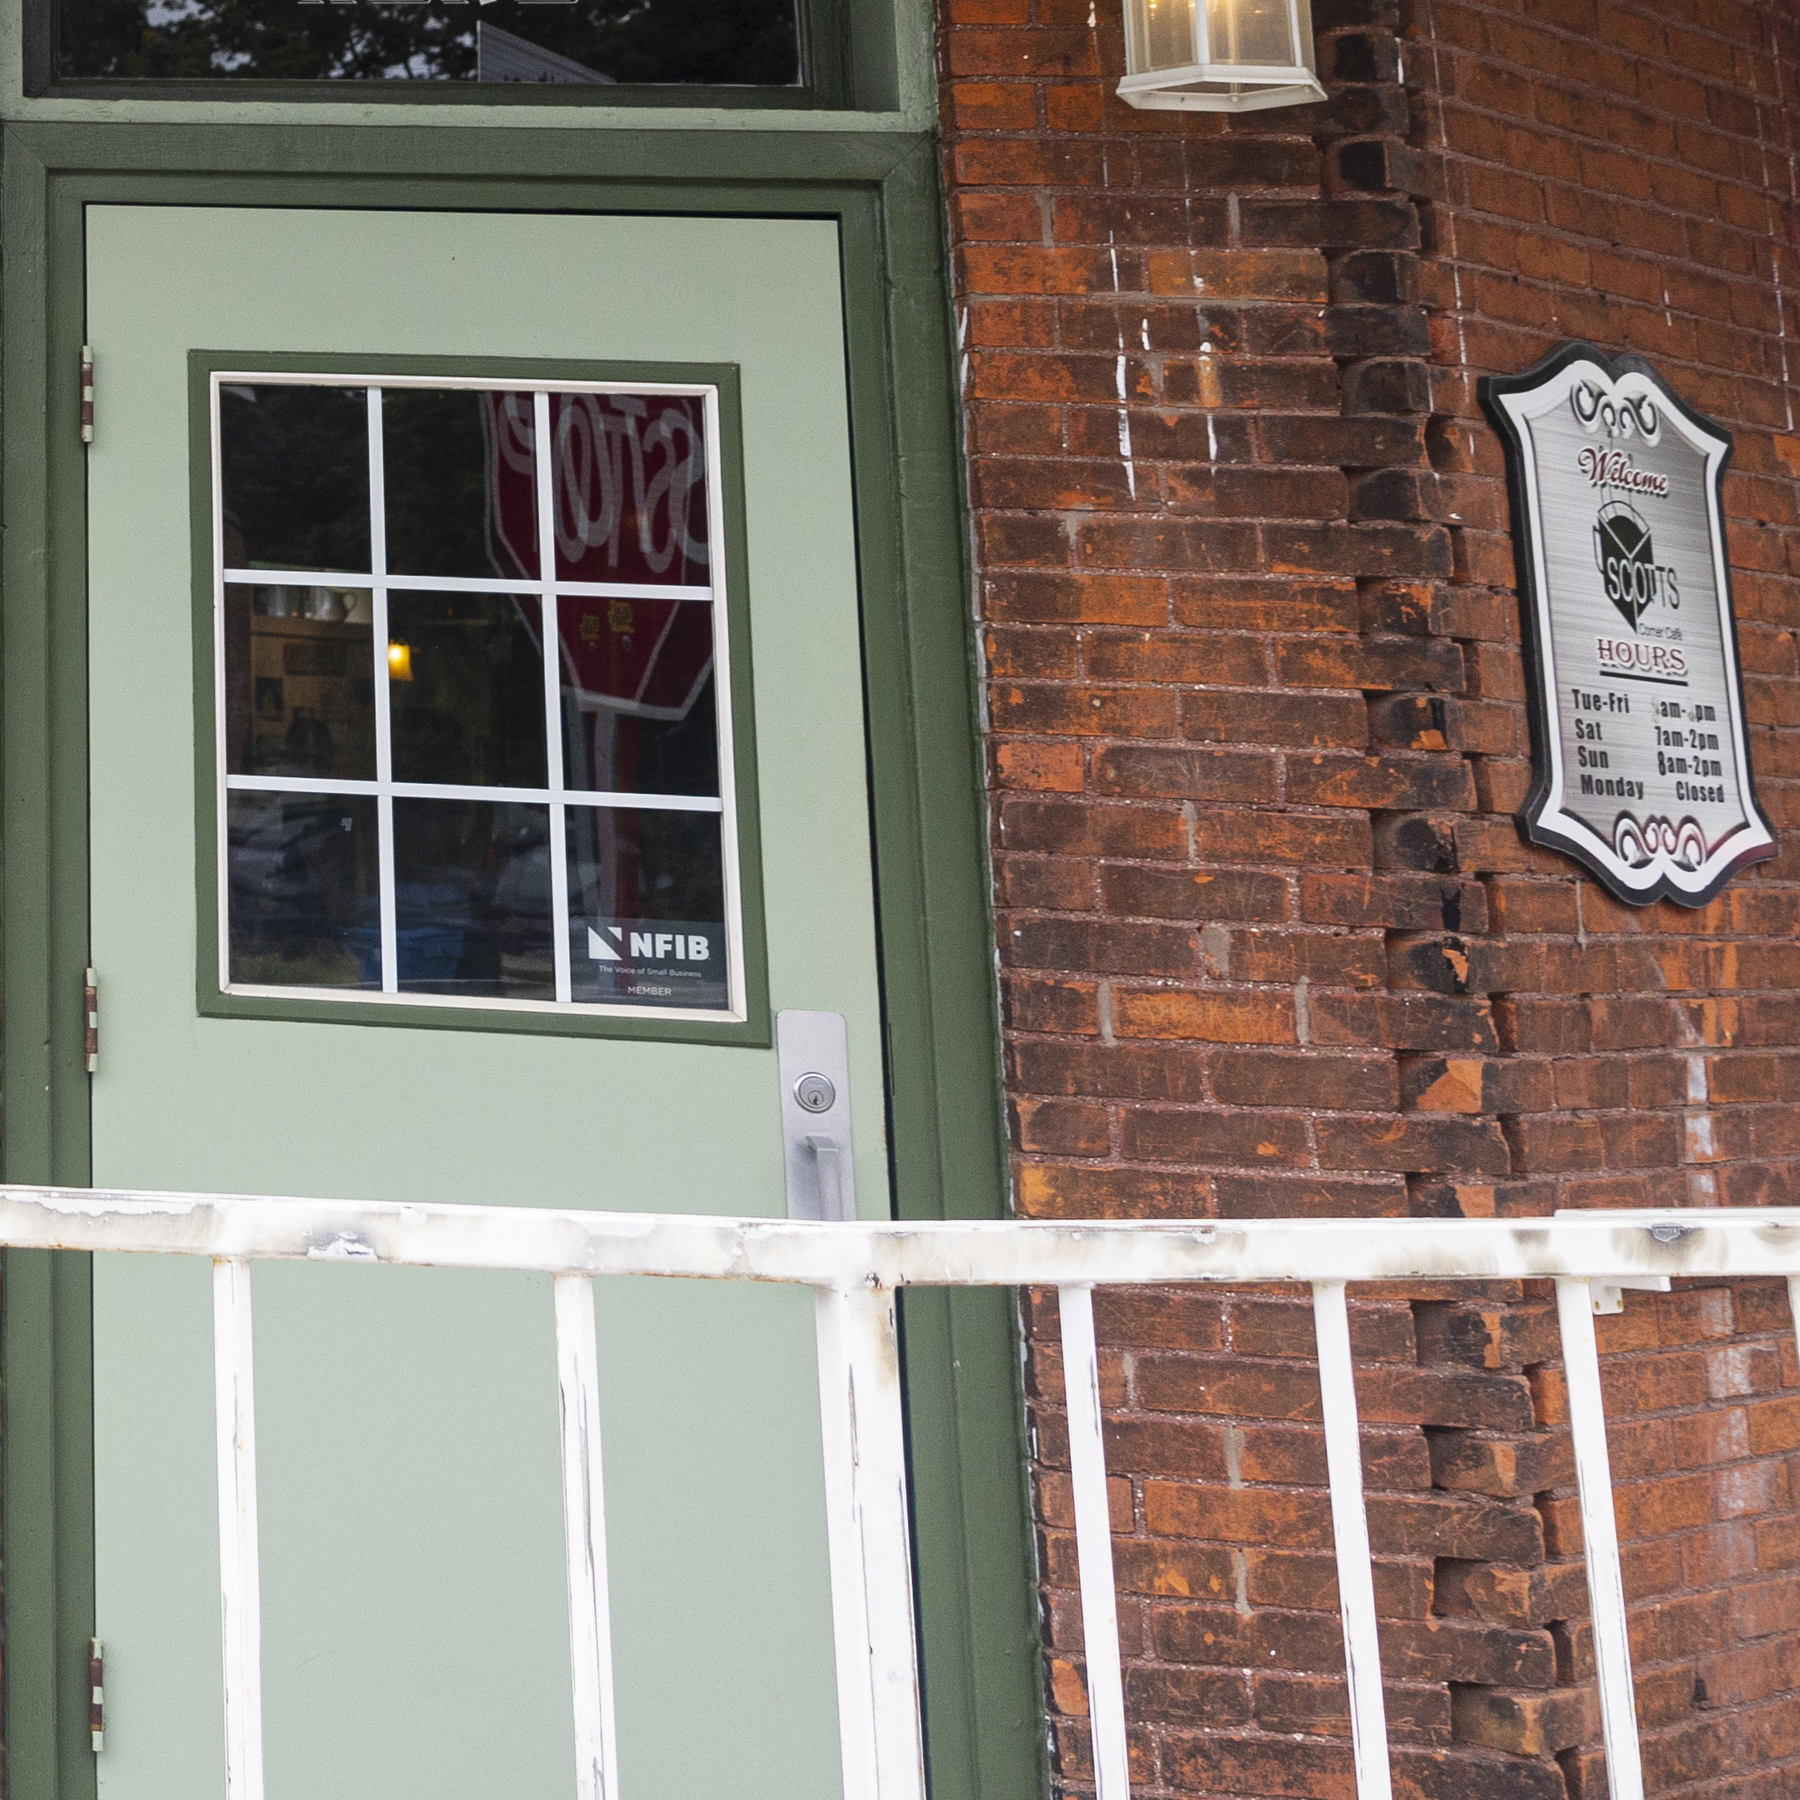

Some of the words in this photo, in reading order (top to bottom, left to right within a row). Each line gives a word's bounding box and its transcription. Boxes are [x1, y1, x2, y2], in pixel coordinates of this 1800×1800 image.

[1577, 447, 1669, 494] Welcome
[1606, 556, 1680, 610] SCOTTS
[1597, 638, 1687, 673] HOURS
[1571, 688, 1630, 714] Tue-Fri
[1575, 718, 1603, 741] Sat
[1654, 725, 1719, 752] 7am-2pm
[1577, 745, 1610, 769] Sun
[1657, 751, 1722, 778] 8am-2pm
[1580, 773, 1644, 801] Monday
[1676, 780, 1725, 804] Closed
[629, 931, 711, 961] NFIB
[615, 966, 635, 975] Voice
[637, 967, 645, 975] of
[646, 968, 667, 976] Small
[669, 969, 701, 978] Business
[627, 986, 672, 996] MEMBER
